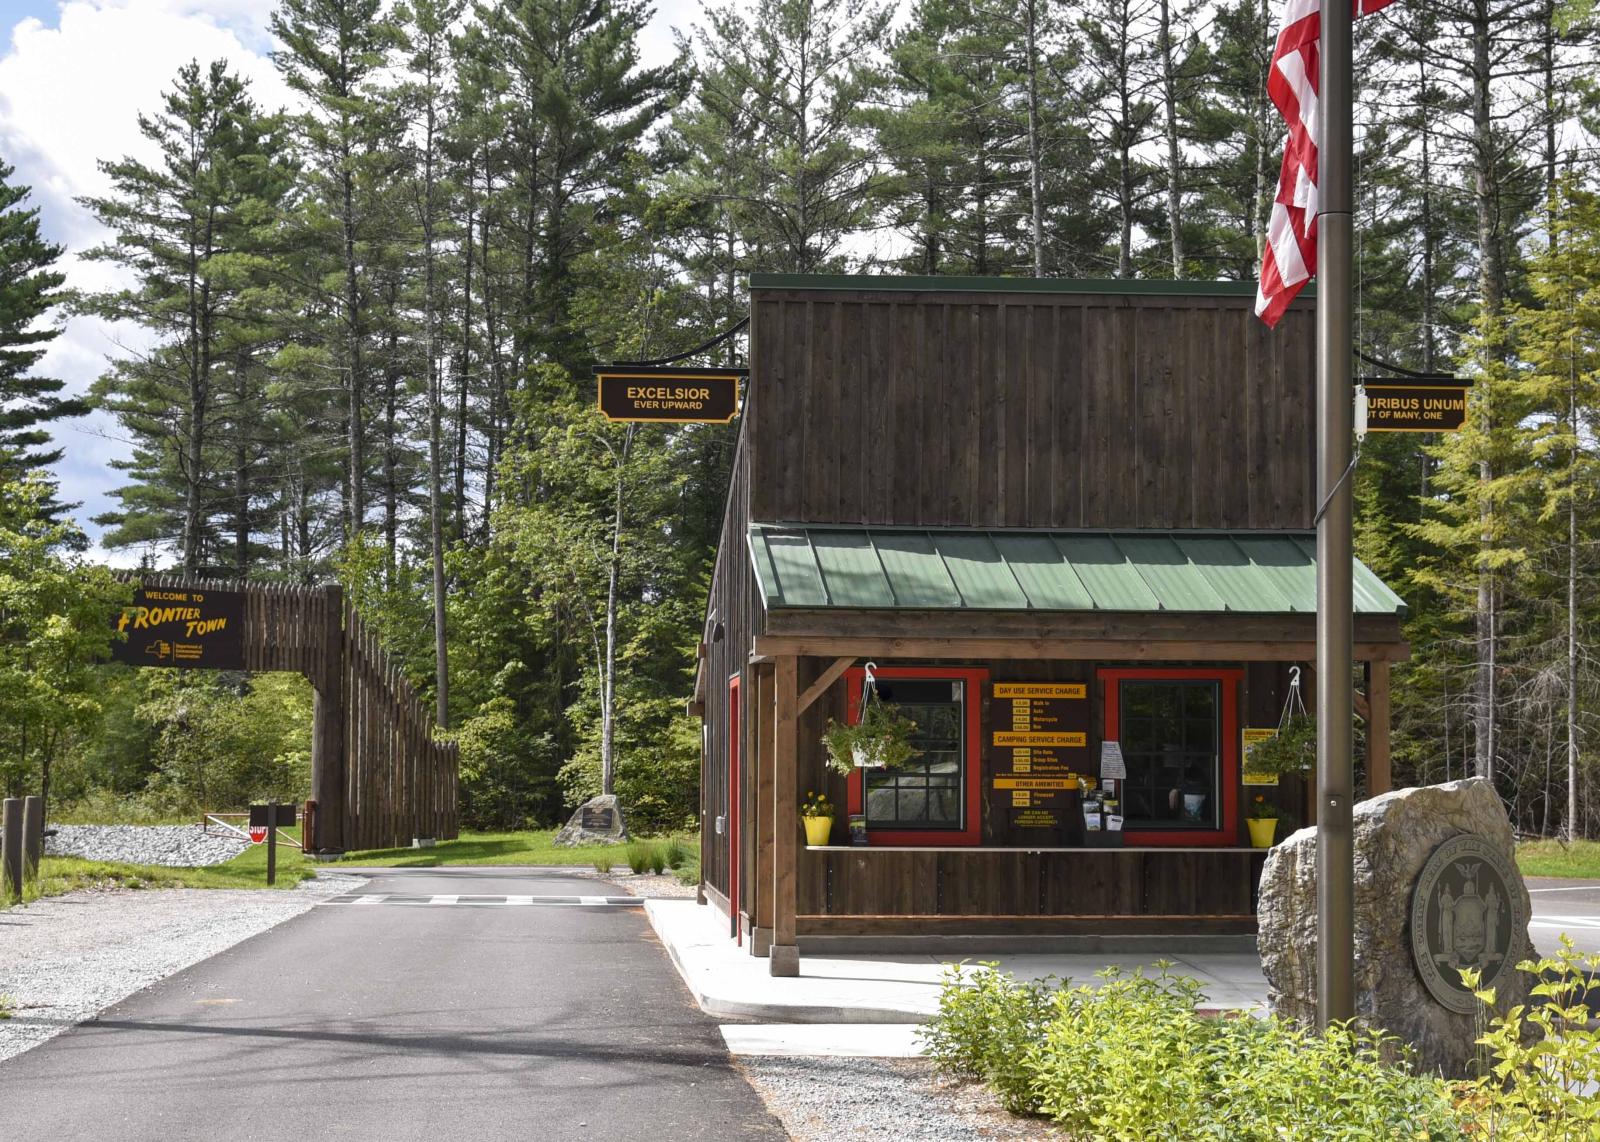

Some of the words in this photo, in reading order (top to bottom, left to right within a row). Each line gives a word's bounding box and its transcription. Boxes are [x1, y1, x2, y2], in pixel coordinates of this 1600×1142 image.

[627, 387, 710, 399] EXCELSIOR
[634, 401, 659, 409] EVER
[661, 401, 703, 410] UPWARD
[1367, 398, 1420, 409] URIBUS
[1423, 399, 1464, 410] UNUM
[1393, 411, 1421, 420] MANY,
[145, 591, 187, 601] WELCOME
[192, 594, 204, 602] TO
[118, 606, 201, 633] FRONTIER
[186, 618, 227, 638] TOWN
